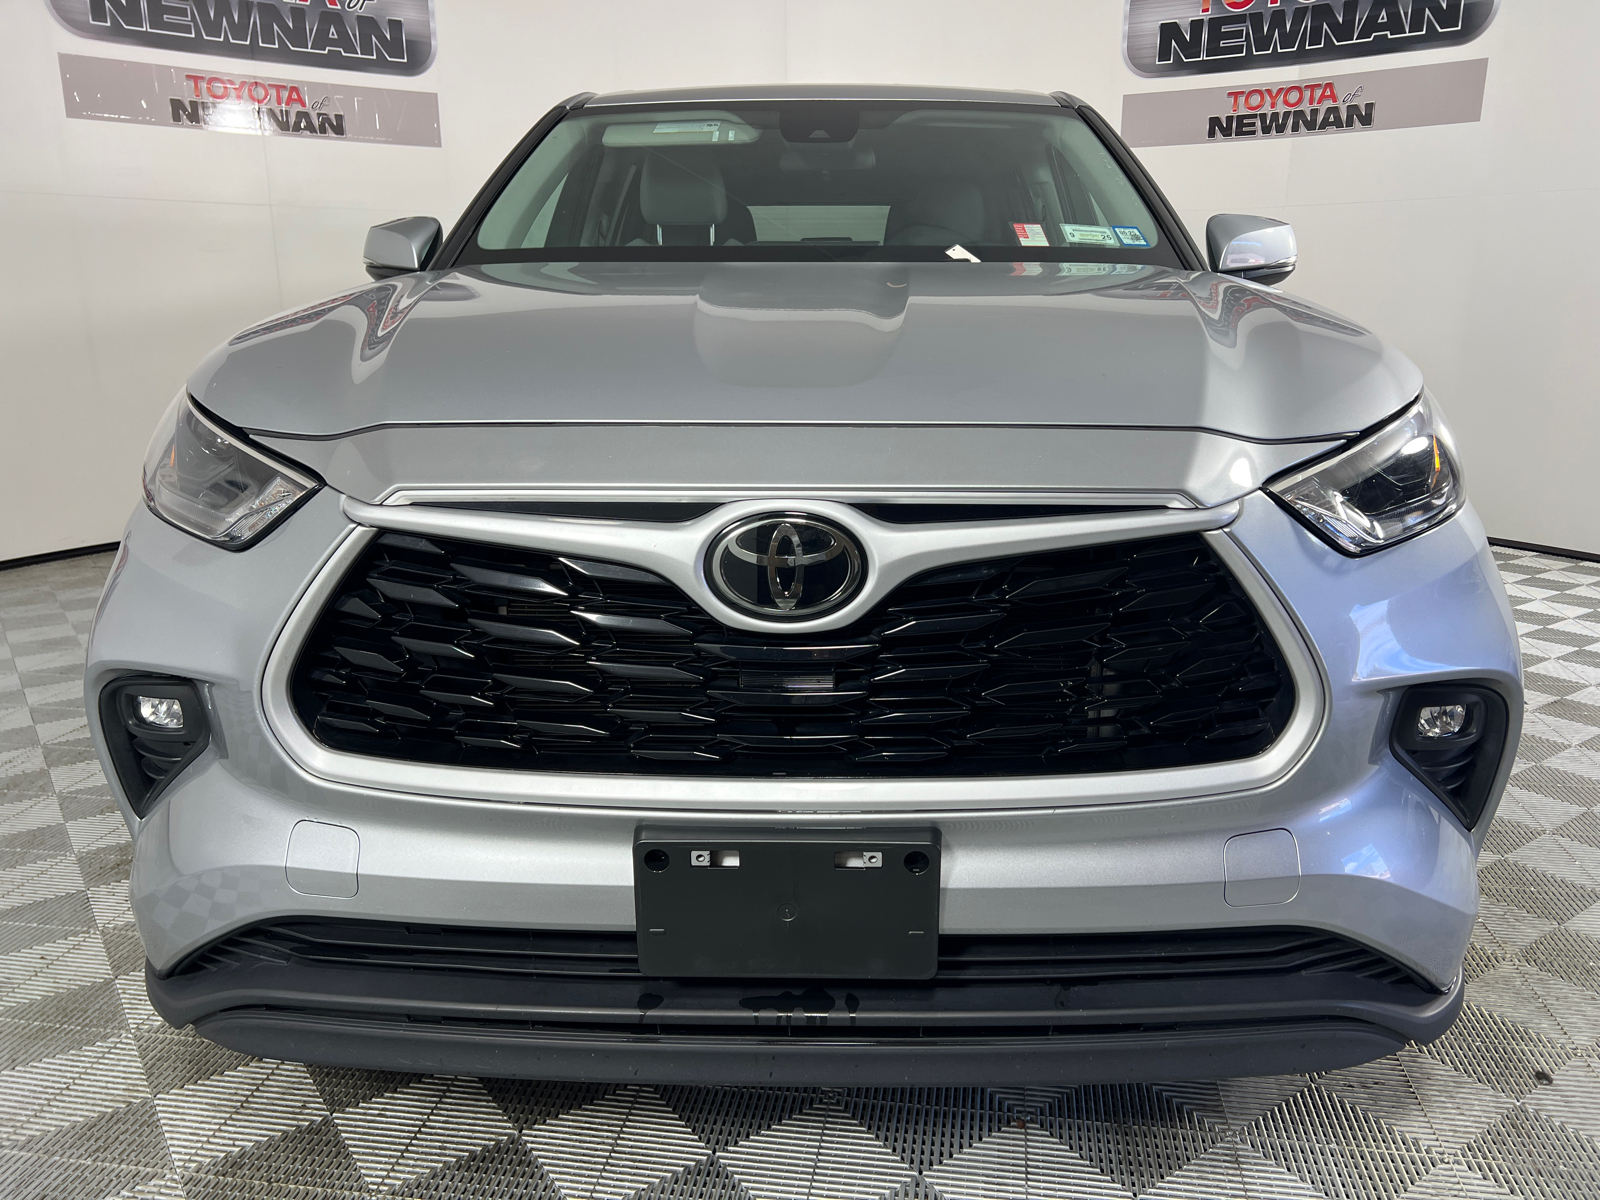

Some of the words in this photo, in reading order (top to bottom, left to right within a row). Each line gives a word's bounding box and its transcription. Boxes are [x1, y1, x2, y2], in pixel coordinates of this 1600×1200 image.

[89, 0, 407, 61] NEWNAN
[1155, 0, 1466, 64] NEWNAN
[185, 74, 307, 108] TOYOTA
[311, 96, 329, 110] of
[1227, 81, 1338, 113] TOYOTA
[1342, 85, 1364, 104] of
[169, 97, 346, 137] NNAN
[1206, 101, 1376, 139] NEWNAN
